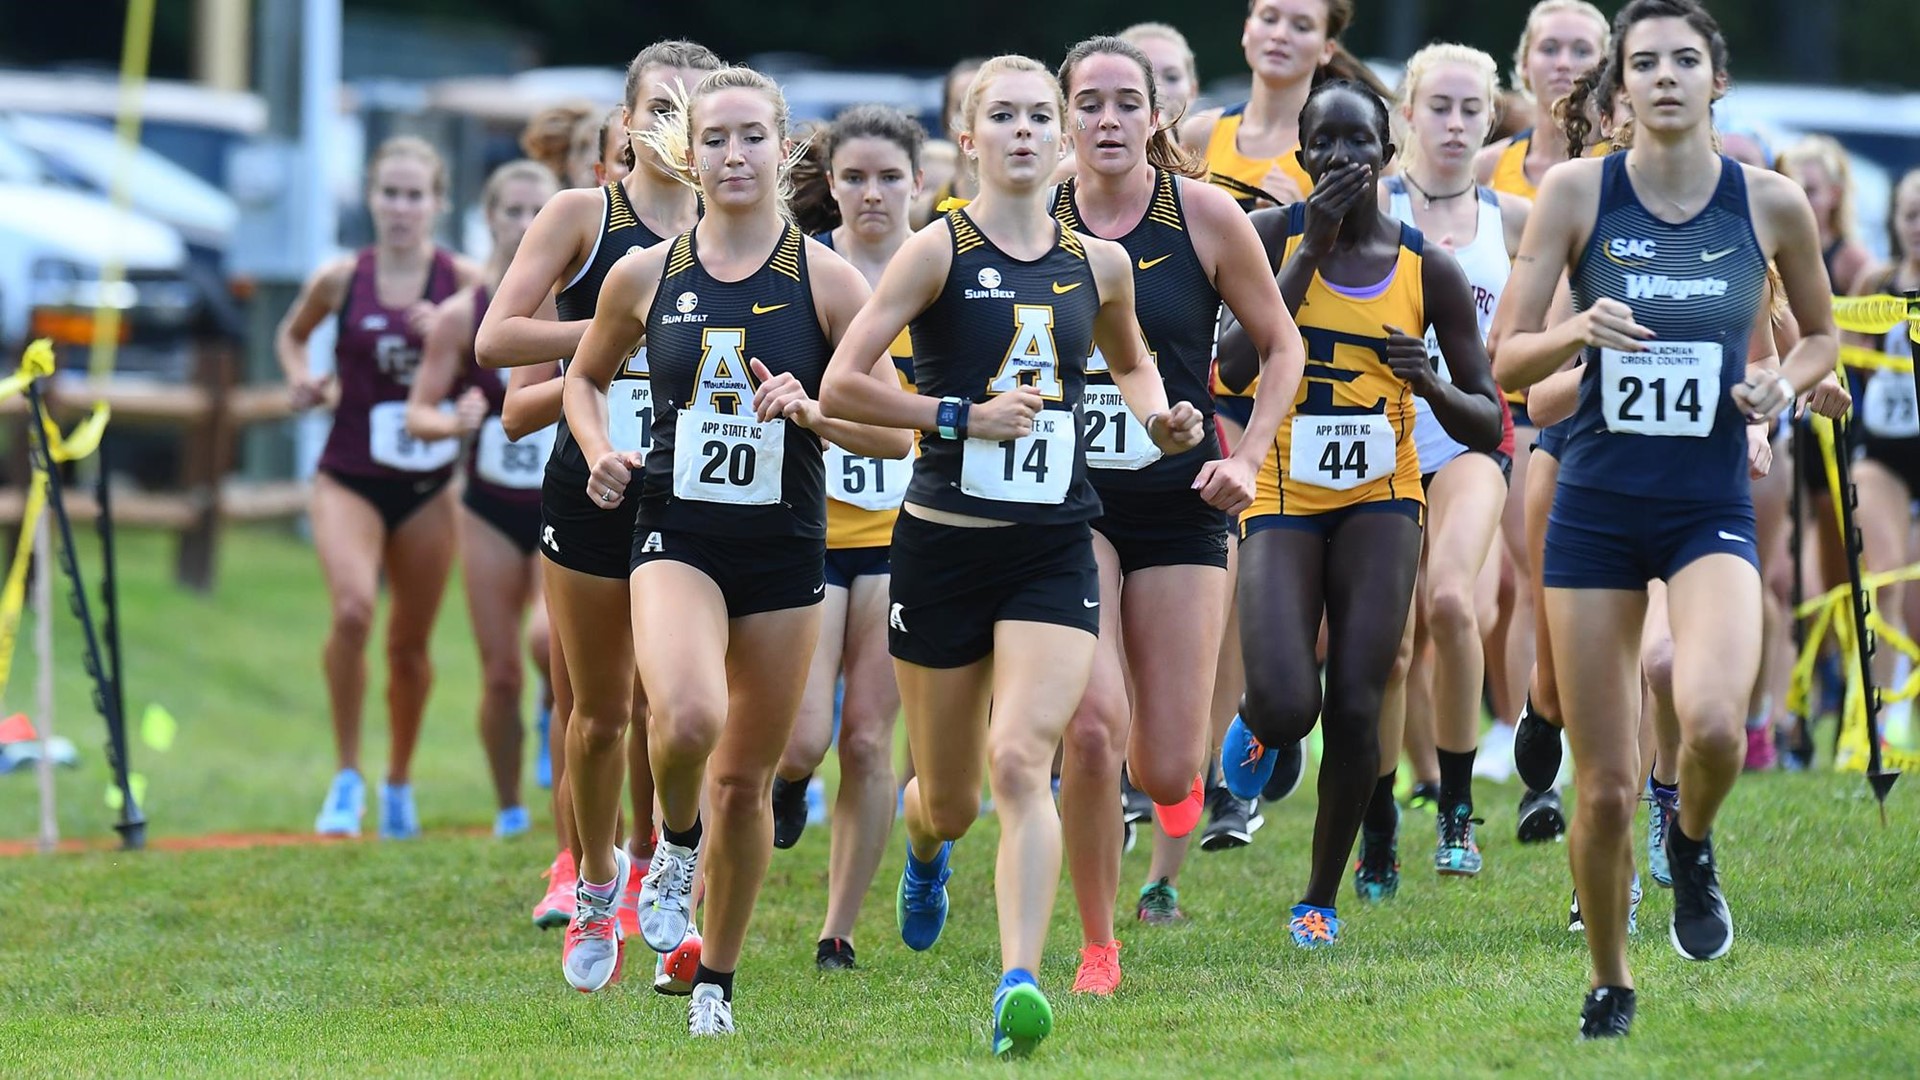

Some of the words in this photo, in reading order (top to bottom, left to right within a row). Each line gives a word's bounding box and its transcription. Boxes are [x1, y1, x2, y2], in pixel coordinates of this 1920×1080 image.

[1610, 238, 1656, 258] SAC
[964, 289, 989, 299] SUN
[990, 288, 1016, 299] BELT
[1622, 274, 1728, 299] Wingate
[661, 314, 682, 325] SUN
[683, 313, 708, 322] BELT
[986, 303, 1064, 401] A
[1621, 356, 1653, 365] CROSS
[631, 388, 649, 400] APP
[1100, 393, 1124, 406] STATE
[1618, 376, 1703, 422] 214
[701, 421, 720, 435] APP
[722, 423, 748, 439] STATE
[750, 426, 762, 440] XC
[1043, 421, 1056, 433] XC
[1083, 410, 1127, 454] 21
[1316, 425, 1333, 436] APP
[1335, 424, 1358, 436] STATE
[1360, 424, 1371, 436] XC
[700, 440, 756, 487] 20
[998, 438, 1049, 483] 14
[1318, 440, 1369, 480] 44
[843, 455, 884, 494] 51
